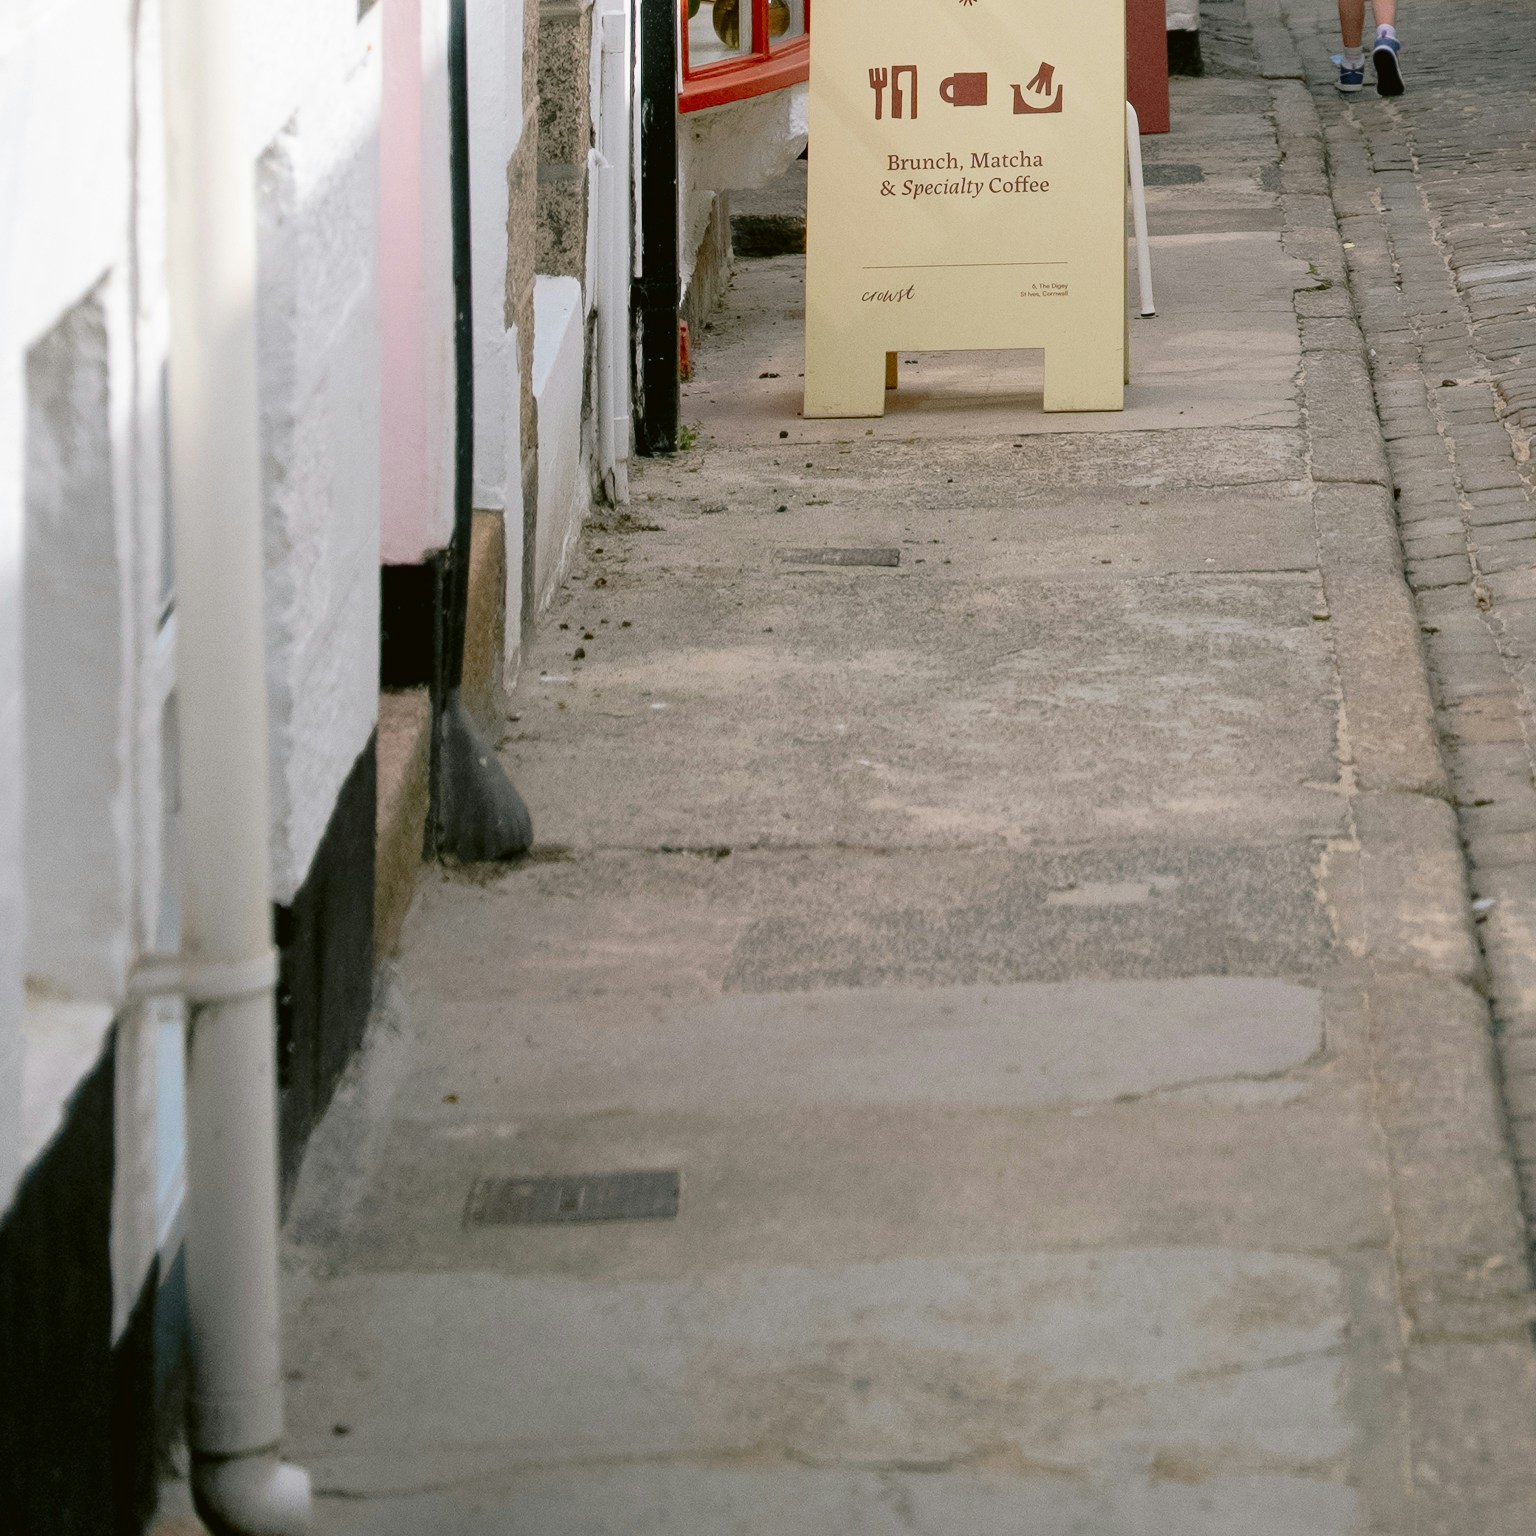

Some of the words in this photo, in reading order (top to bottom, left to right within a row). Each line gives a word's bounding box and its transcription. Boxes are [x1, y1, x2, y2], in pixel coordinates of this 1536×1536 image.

[887, 152, 964, 171] Brunch,
[970, 150, 1043, 169] Matcha
[880, 179, 896, 197] &
[901, 177, 984, 200] Specialty
[988, 175, 1050, 194] Coffee
[861, 284, 915, 303] crowst
